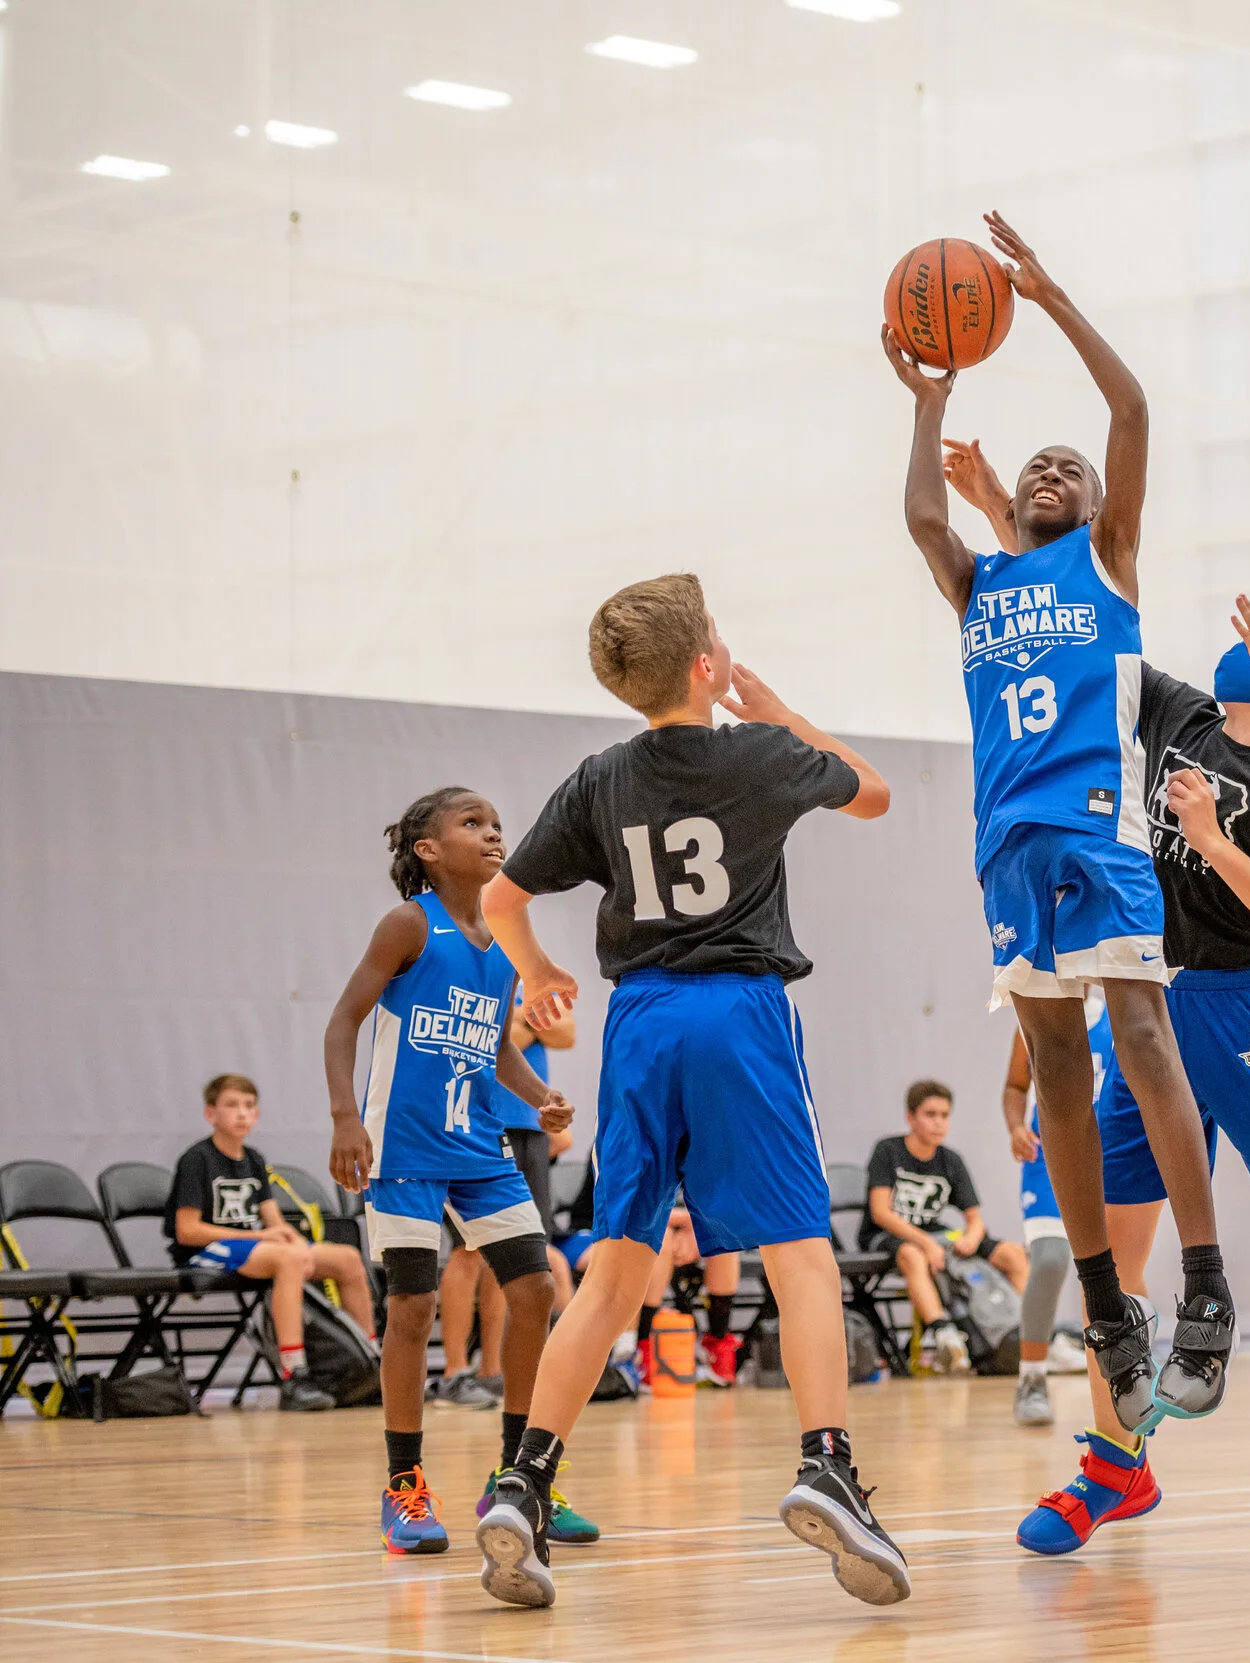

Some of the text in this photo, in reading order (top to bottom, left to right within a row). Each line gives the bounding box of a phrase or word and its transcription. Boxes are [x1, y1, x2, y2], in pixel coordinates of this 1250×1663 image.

[908, 263, 939, 350] Baden
[965, 277, 979, 327] ELITE
[982, 586, 1052, 618] TEAM
[962, 608, 1092, 660] DELAWARE
[985, 638, 1067, 661] BASKETBALL
[1000, 675, 1058, 741] 13
[622, 816, 730, 921] 13
[414, 1010, 499, 1054] DELAWAR
[452, 990, 497, 1026] TEAM
[445, 1077, 471, 1134] 14
